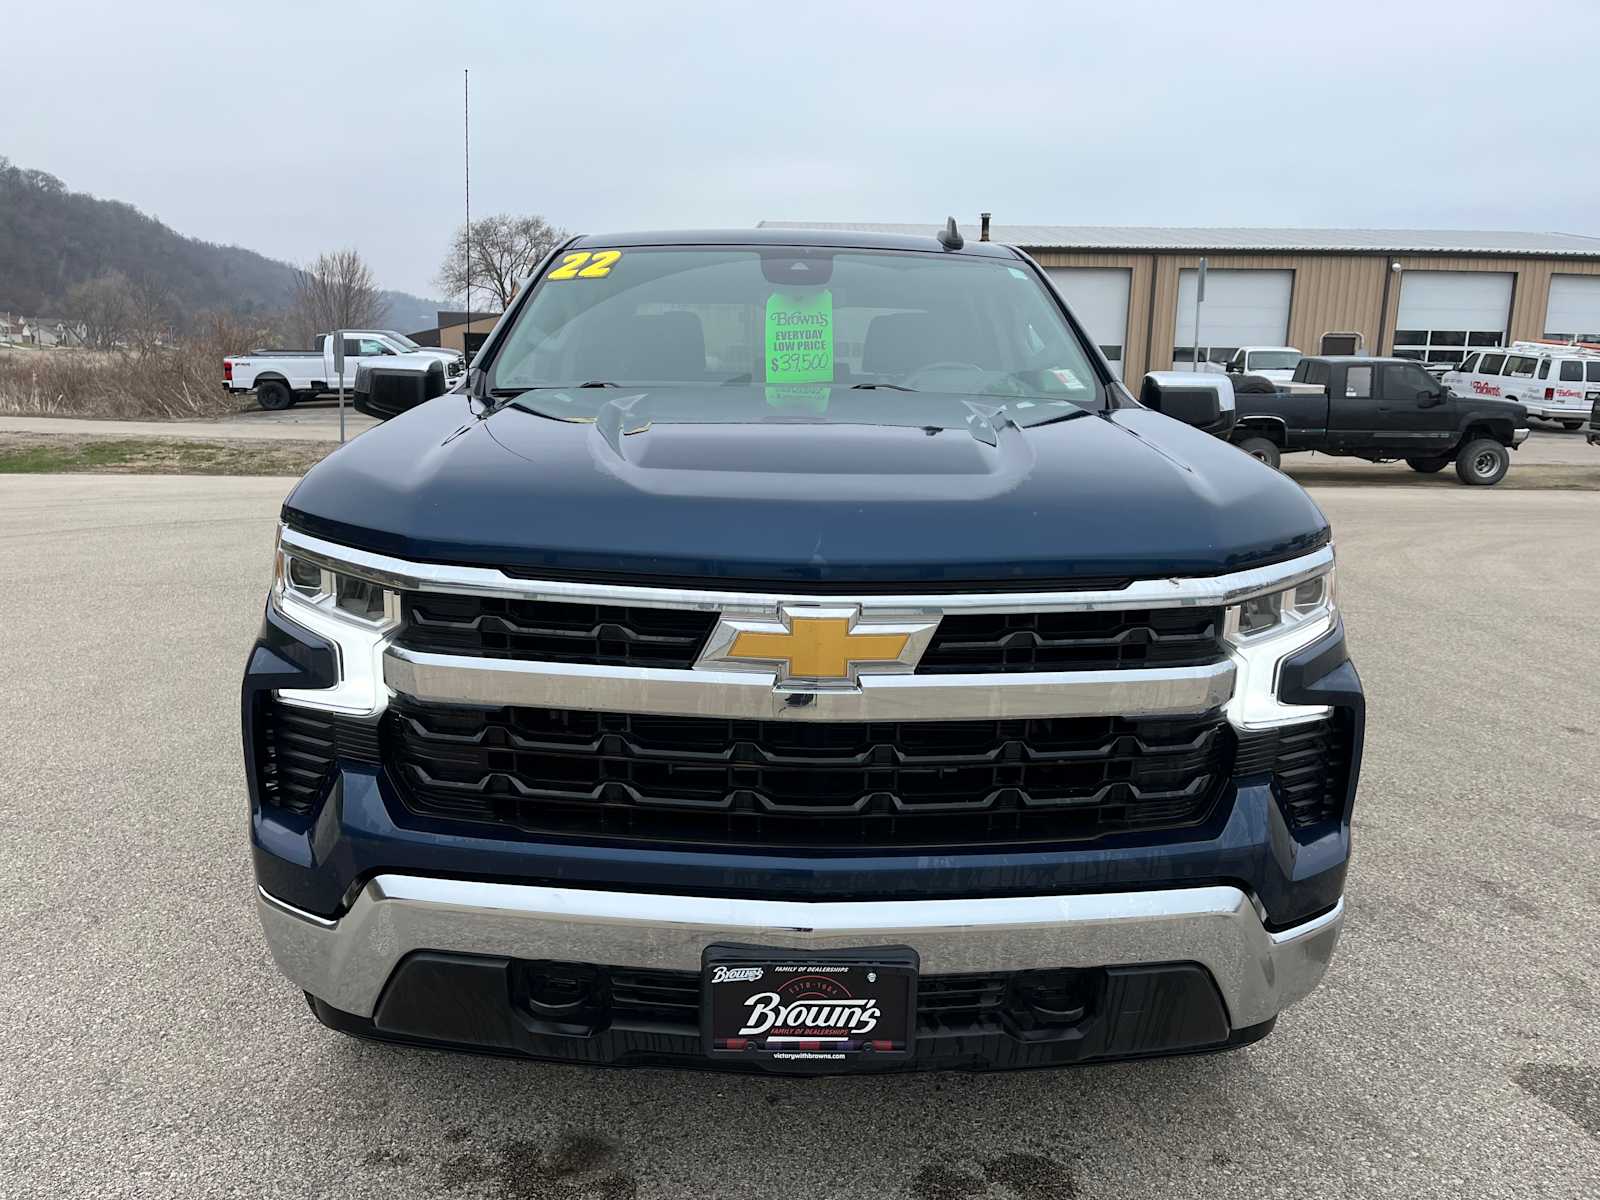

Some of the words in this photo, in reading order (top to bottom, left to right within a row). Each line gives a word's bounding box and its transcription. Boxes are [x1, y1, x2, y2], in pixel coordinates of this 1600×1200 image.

[548, 249, 622, 281] 22
[770, 311, 829, 327] Brown's
[775, 329, 823, 341] EVERYDAY
[774, 341, 795, 352] LOW
[797, 340, 827, 351] PRICE
[738, 992, 881, 1035] Brown's
[770, 1028, 794, 1036] FAMILY
[804, 1028, 848, 1036] DEALERSHIPS
